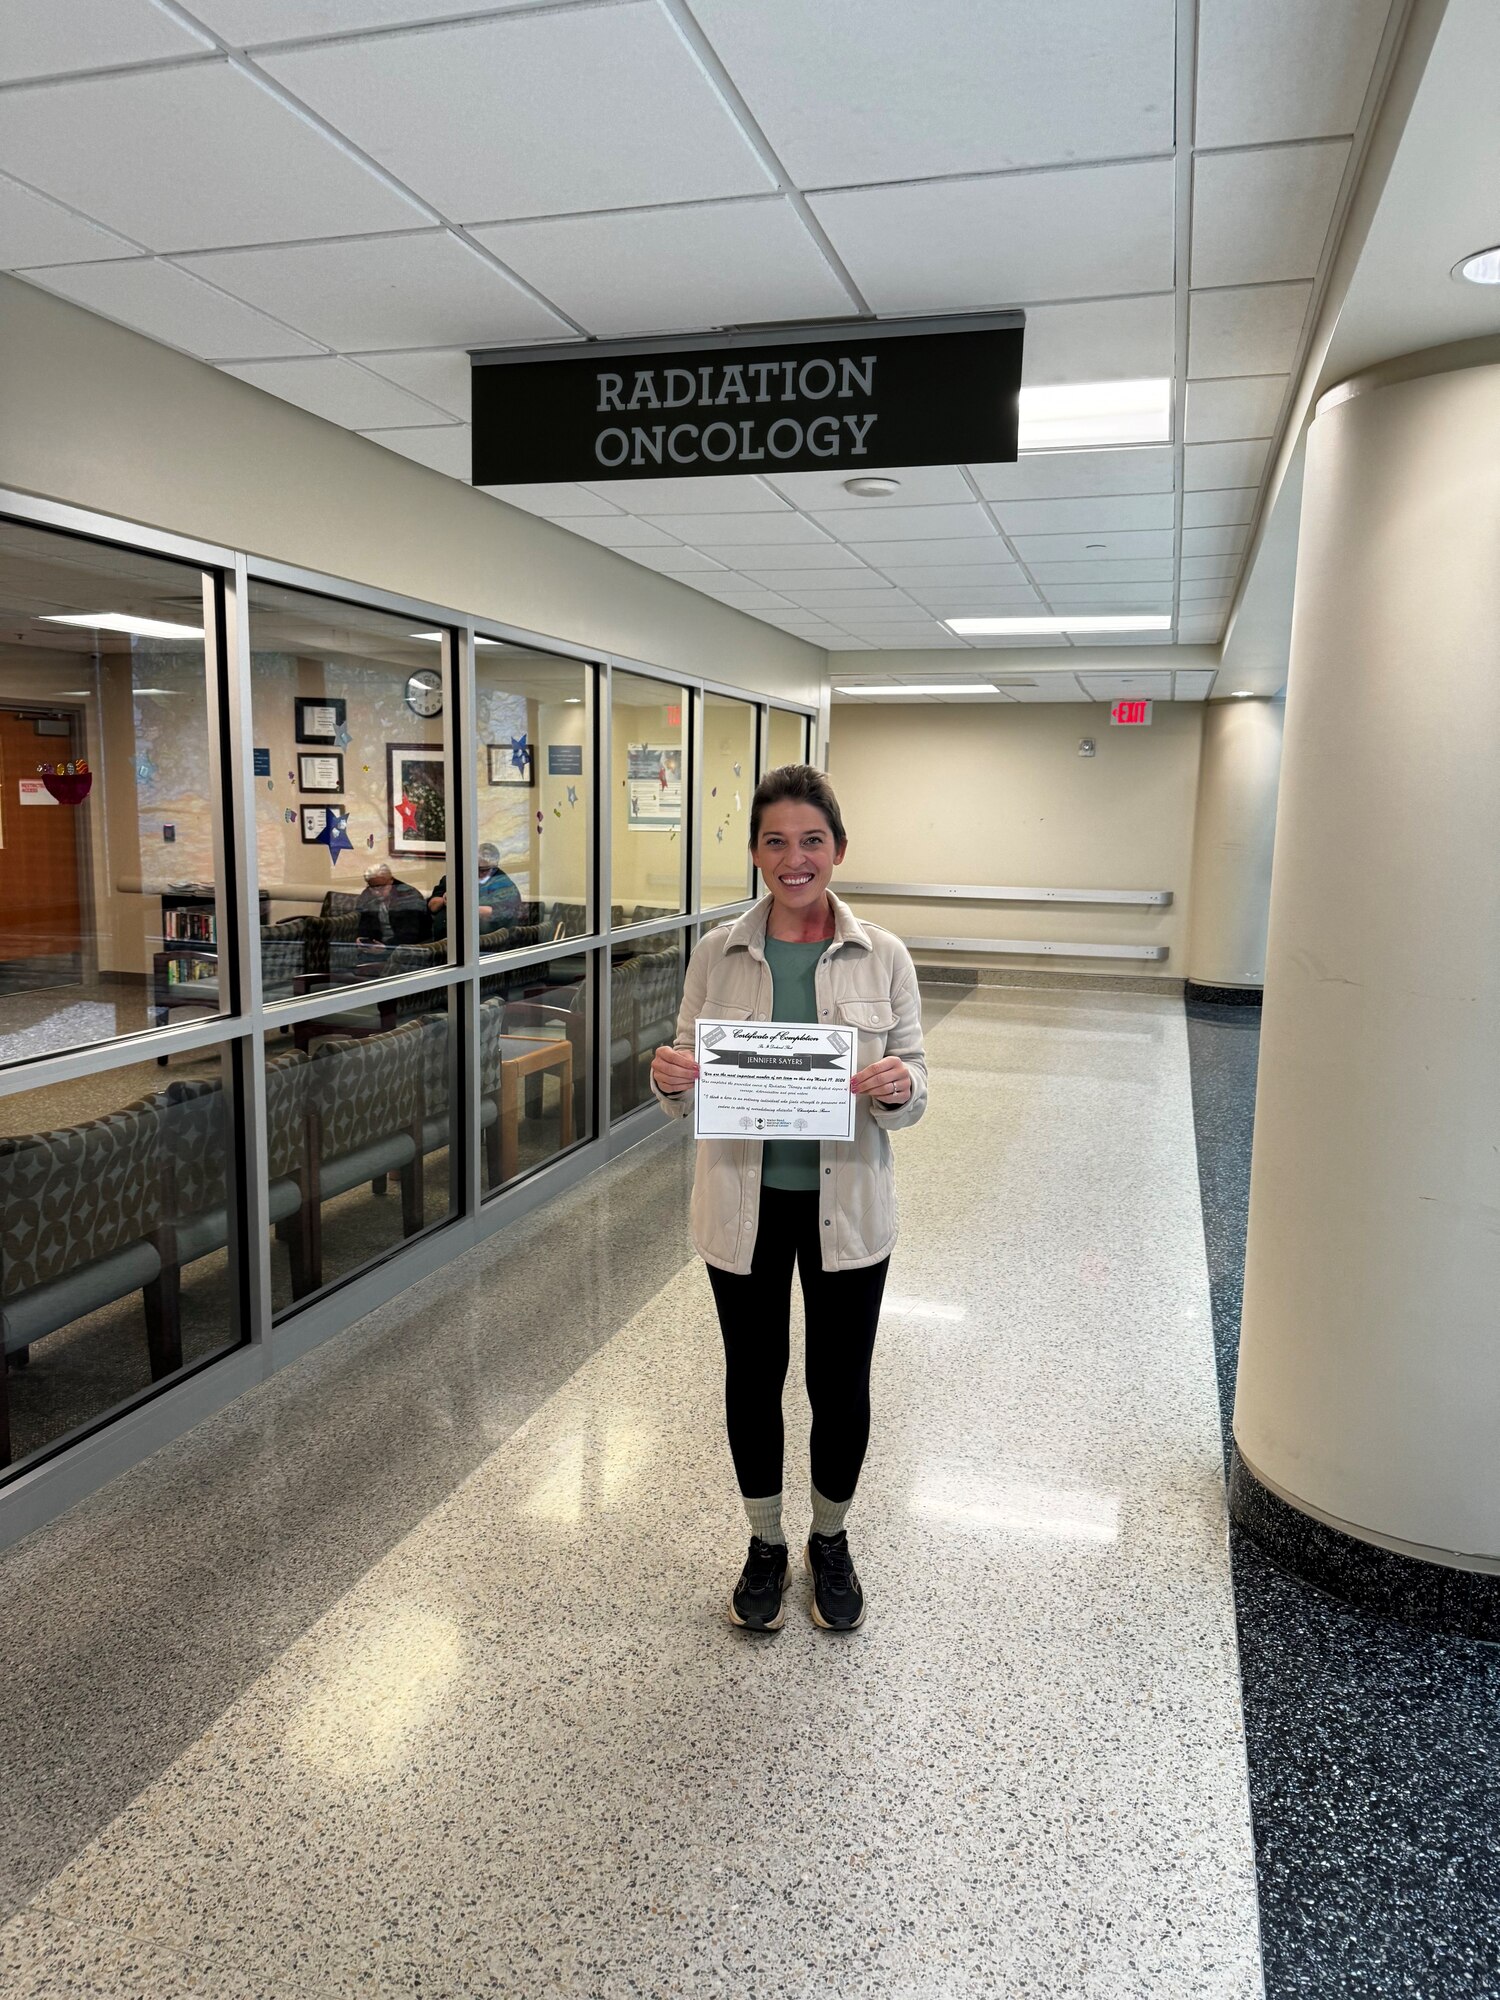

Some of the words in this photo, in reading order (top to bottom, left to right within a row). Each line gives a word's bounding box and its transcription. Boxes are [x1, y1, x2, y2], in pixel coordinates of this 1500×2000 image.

[596, 355, 878, 412] RADIATION
[595, 413, 878, 467] ONCOLOGY
[1118, 701, 1147, 723] EXIT
[733, 1029, 768, 1041] Certificate
[770, 1032, 779, 1042] of
[780, 1031, 819, 1044] Completion
[747, 1056, 777, 1064] JENNIFER
[779, 1057, 803, 1065] SAYERS
